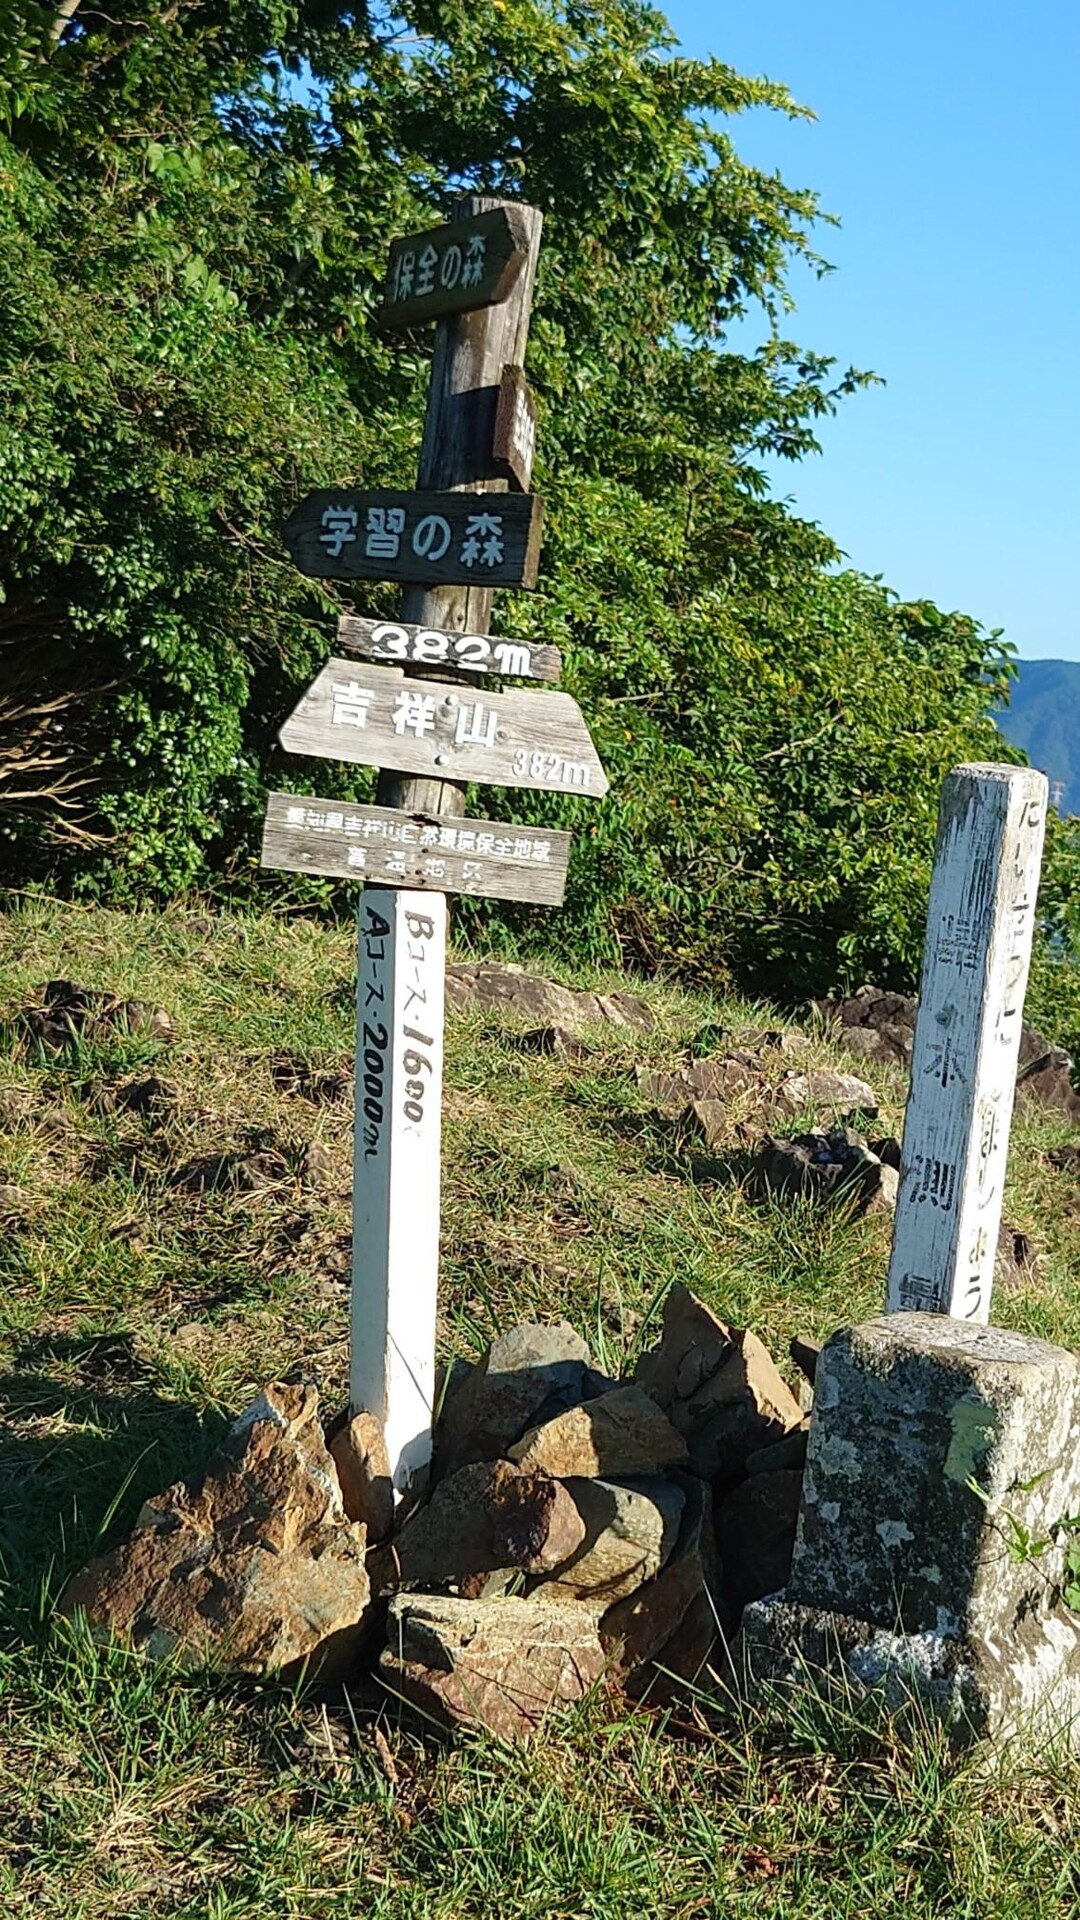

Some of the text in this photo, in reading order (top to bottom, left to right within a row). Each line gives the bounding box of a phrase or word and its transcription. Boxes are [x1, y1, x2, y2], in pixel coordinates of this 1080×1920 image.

[393, 234, 487, 302] 保全の森
[319, 504, 505, 568] 学習の森
[371, 624, 534, 676] 382m
[331, 681, 498, 748] 吉祥山
[511, 749, 591, 787] 382m
[402, 910, 436, 1137] Bコース・1600
